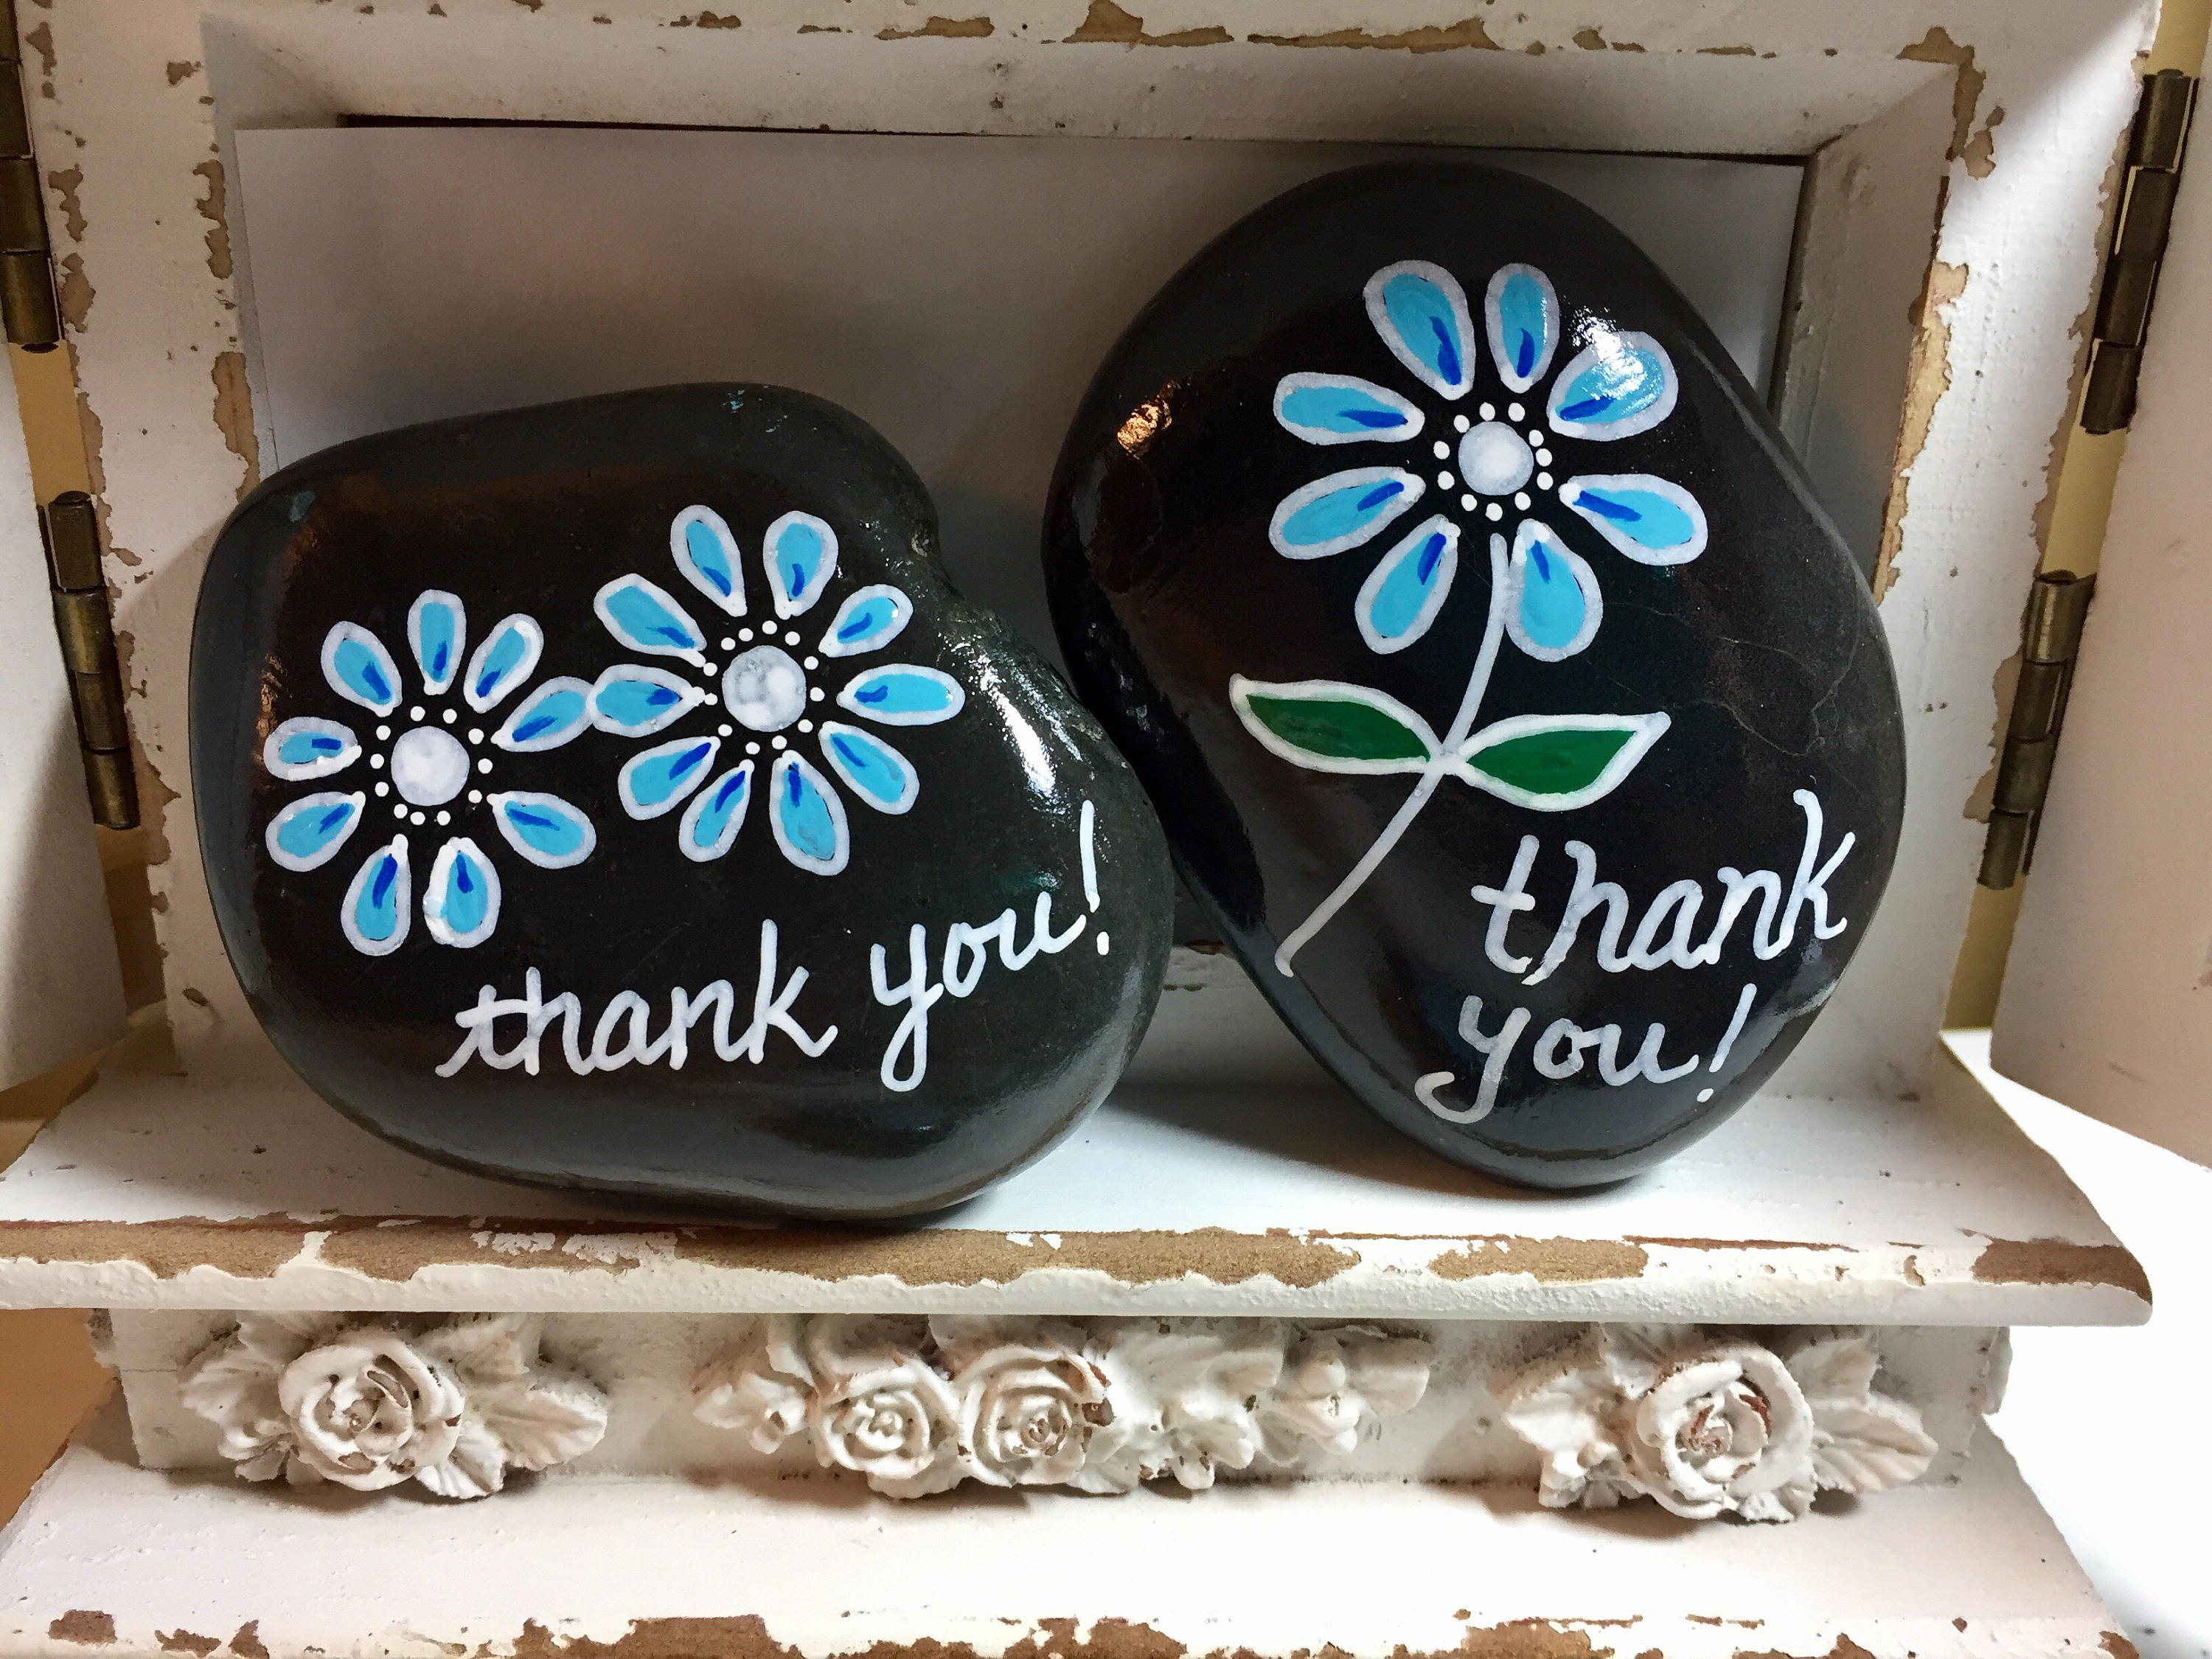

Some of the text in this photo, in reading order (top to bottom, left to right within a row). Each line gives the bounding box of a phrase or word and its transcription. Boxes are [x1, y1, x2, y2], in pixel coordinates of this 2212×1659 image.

[434, 799, 1110, 1092] thank you!
[1470, 788, 1856, 986] thank
[1414, 983, 1757, 1124] you!
